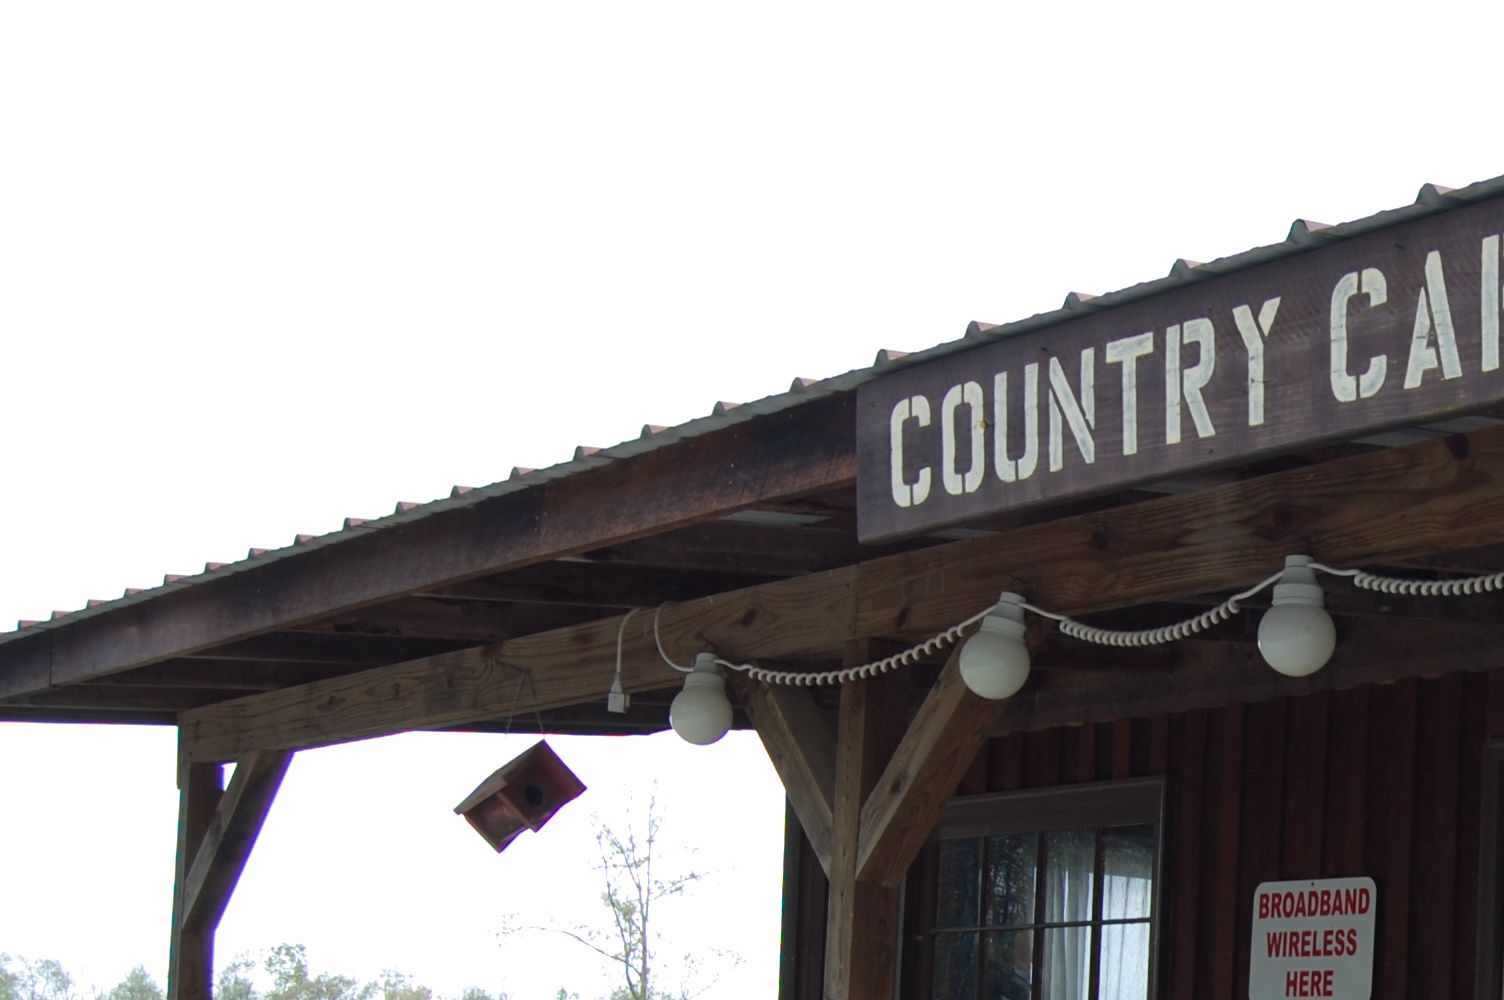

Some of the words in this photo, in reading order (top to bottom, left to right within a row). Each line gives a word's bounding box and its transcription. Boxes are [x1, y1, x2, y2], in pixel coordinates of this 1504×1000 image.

[889, 296, 1281, 508] COUNTRY
[1258, 888, 1371, 919] BROADBAND
[1267, 928, 1357, 958] WIRELESS
[1285, 970, 1334, 997] HERE
